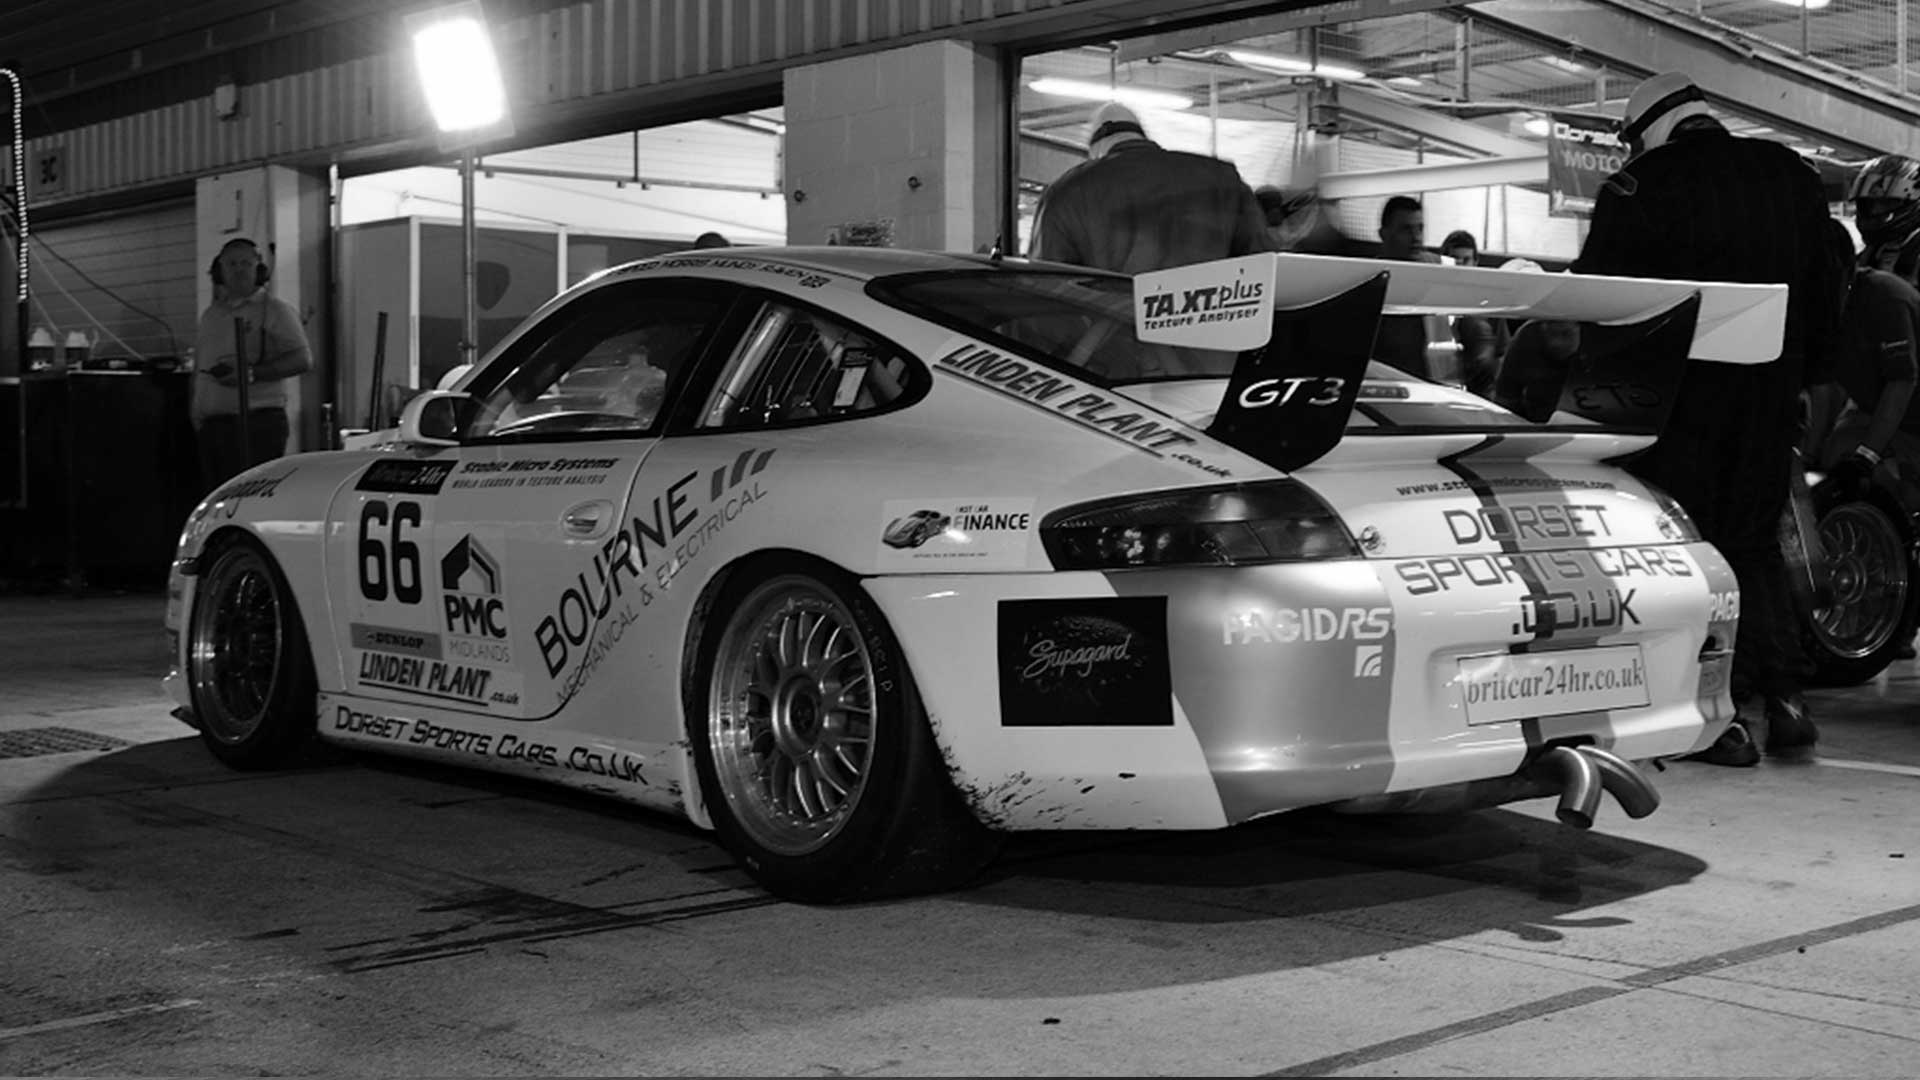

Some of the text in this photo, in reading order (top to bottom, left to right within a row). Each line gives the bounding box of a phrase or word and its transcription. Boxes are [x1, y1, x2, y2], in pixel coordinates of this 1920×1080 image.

[1144, 308, 1259, 331] Texture Analyser
[940, 343, 1077, 402] LINDEN
[1057, 393, 1198, 448] PLANT
[508, 459, 549, 473] Micro
[549, 457, 620, 473] Systems
[639, 582, 655, 607] &
[655, 482, 768, 592] ELECTRICAL
[953, 513, 1030, 531] FINANCE
[1441, 504, 1612, 546] DORSET
[358, 499, 422, 605] 66
[534, 470, 698, 680] BOURNE
[1394, 544, 1693, 596] SPORTS CARS
[375, 631, 425, 649] DUNLOP
[443, 593, 507, 639] PMC
[359, 651, 425, 688] LINDEN
[427, 661, 492, 699] PLANT
[1467, 657, 1644, 705] britcar24hr.co.uk
